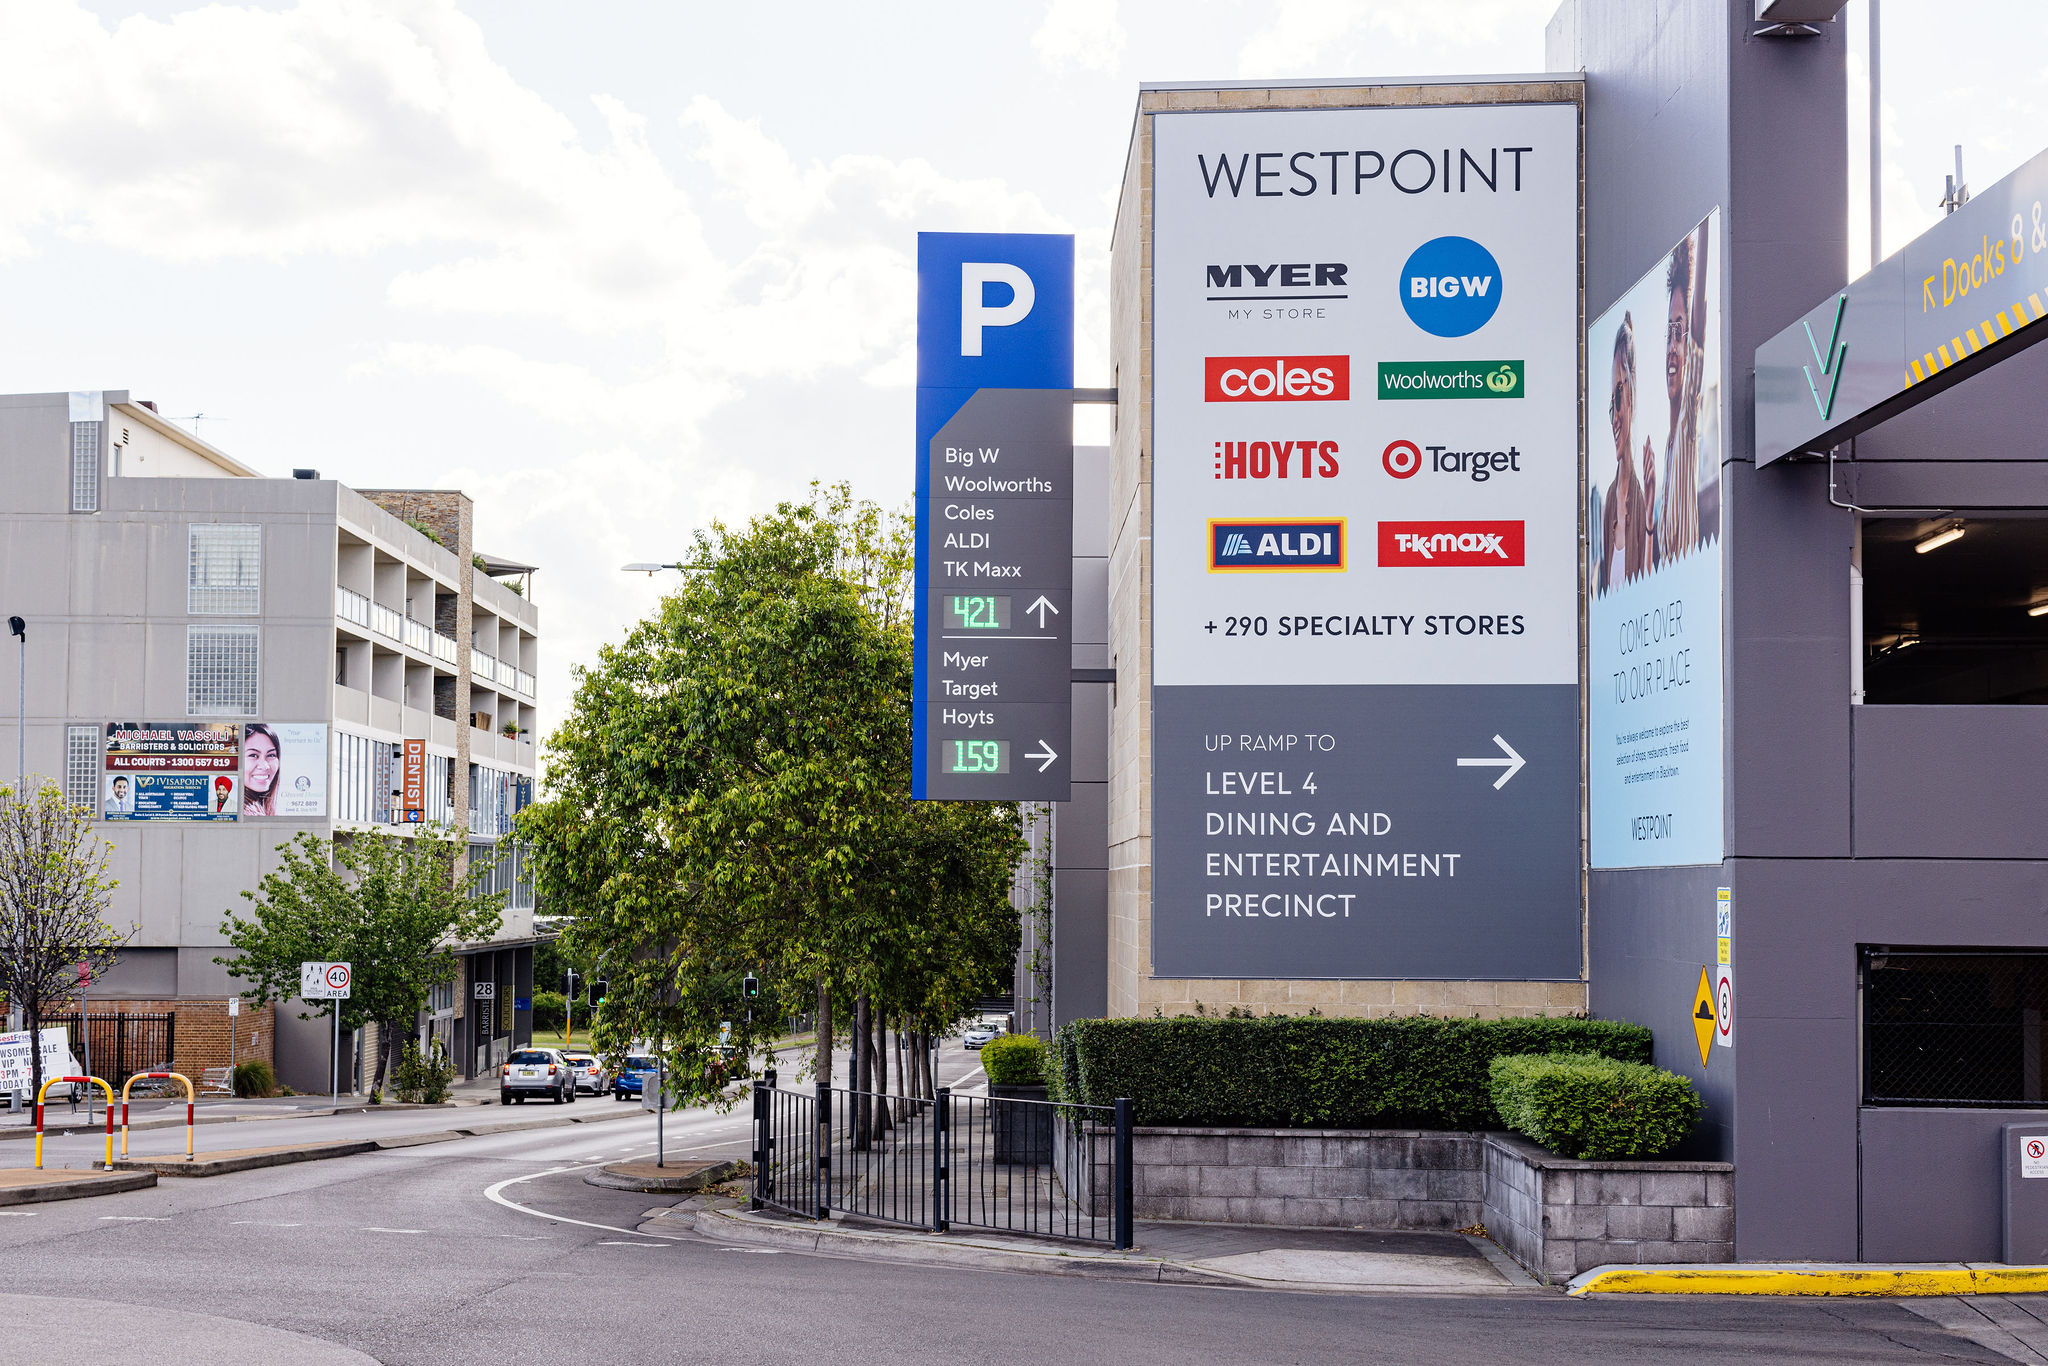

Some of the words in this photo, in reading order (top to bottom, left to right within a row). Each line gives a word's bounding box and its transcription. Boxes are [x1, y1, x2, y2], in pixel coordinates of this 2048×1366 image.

[1197, 147, 1533, 198] WESTPOINT
[1943, 235, 2004, 307] Docks
[2011, 213, 2024, 264] 8
[2031, 201, 2046, 253] &
[1207, 263, 1348, 288] MYER
[961, 262, 1036, 357] P
[1228, 309, 1253, 320] MY
[1263, 308, 1326, 320] STORE
[1220, 360, 1334, 397] coles
[1384, 370, 1484, 391] Woolworths
[945, 446, 975, 467] Big
[977, 447, 1000, 464] W
[1225, 441, 1340, 480] HOYTS
[1425, 445, 1521, 482] Target
[944, 475, 1053, 494] Woolworths
[944, 504, 995, 521] Coles
[944, 532, 990, 549] ALDI
[1257, 533, 1332, 556] ALDI
[944, 561, 971, 579] TK
[974, 561, 1022, 578] Maxx
[954, 596, 1000, 629] 421
[1225, 616, 1269, 637] 290
[1278, 615, 1415, 636] SPECIALTY
[1424, 614, 1525, 635] STORES
[1619, 612, 1650, 656] COME
[1652, 599, 1684, 643] OVER
[943, 651, 989, 671] Myer
[1613, 670, 1628, 705] TO
[1630, 661, 1653, 701] OUR
[1656, 648, 1691, 694] PLACE
[942, 680, 999, 700] Target
[942, 708, 994, 729] Hoyts
[116, 730, 175, 741] MICHAEL
[177, 730, 229, 742] VASSILI
[120, 743, 168, 751] BARRISTERS
[170, 743, 176, 751] &
[178, 743, 225, 751] SOLICITORS
[1205, 735, 1232, 752] UP
[1240, 735, 1298, 752] RAMP
[1305, 734, 1336, 751] TO
[114, 757, 130, 766] ALL
[131, 757, 166, 766] COURTS
[171, 758, 194, 767] 1300
[195, 758, 211, 767] 557
[213, 758, 231, 767] 819
[953, 740, 999, 772] 159
[407, 743, 421, 809] DENTIST
[1206, 772, 1292, 795] LEVEL
[1302, 772, 1318, 795] 4
[1206, 813, 1316, 836] DINING
[1326, 813, 1392, 836] AND
[1631, 813, 1673, 841] WESTPOINT
[1206, 853, 1462, 877] ENTERTAINMENT
[1206, 894, 1356, 918] PRECINCT
[329, 971, 347, 983] 40
[326, 990, 348, 998] AREA
[476, 983, 493, 996] 28
[481, 999, 490, 1035] BARRISTE
[502, 986, 511, 1029] SOLICITORS
[1721, 992, 1728, 1020] 8
[0, 1033, 44, 1041] estFries
[1, 1069, 19, 1080] 3PM
[27, 1066, 47, 1077] 7M
[2, 1059, 15, 1069] VIP
